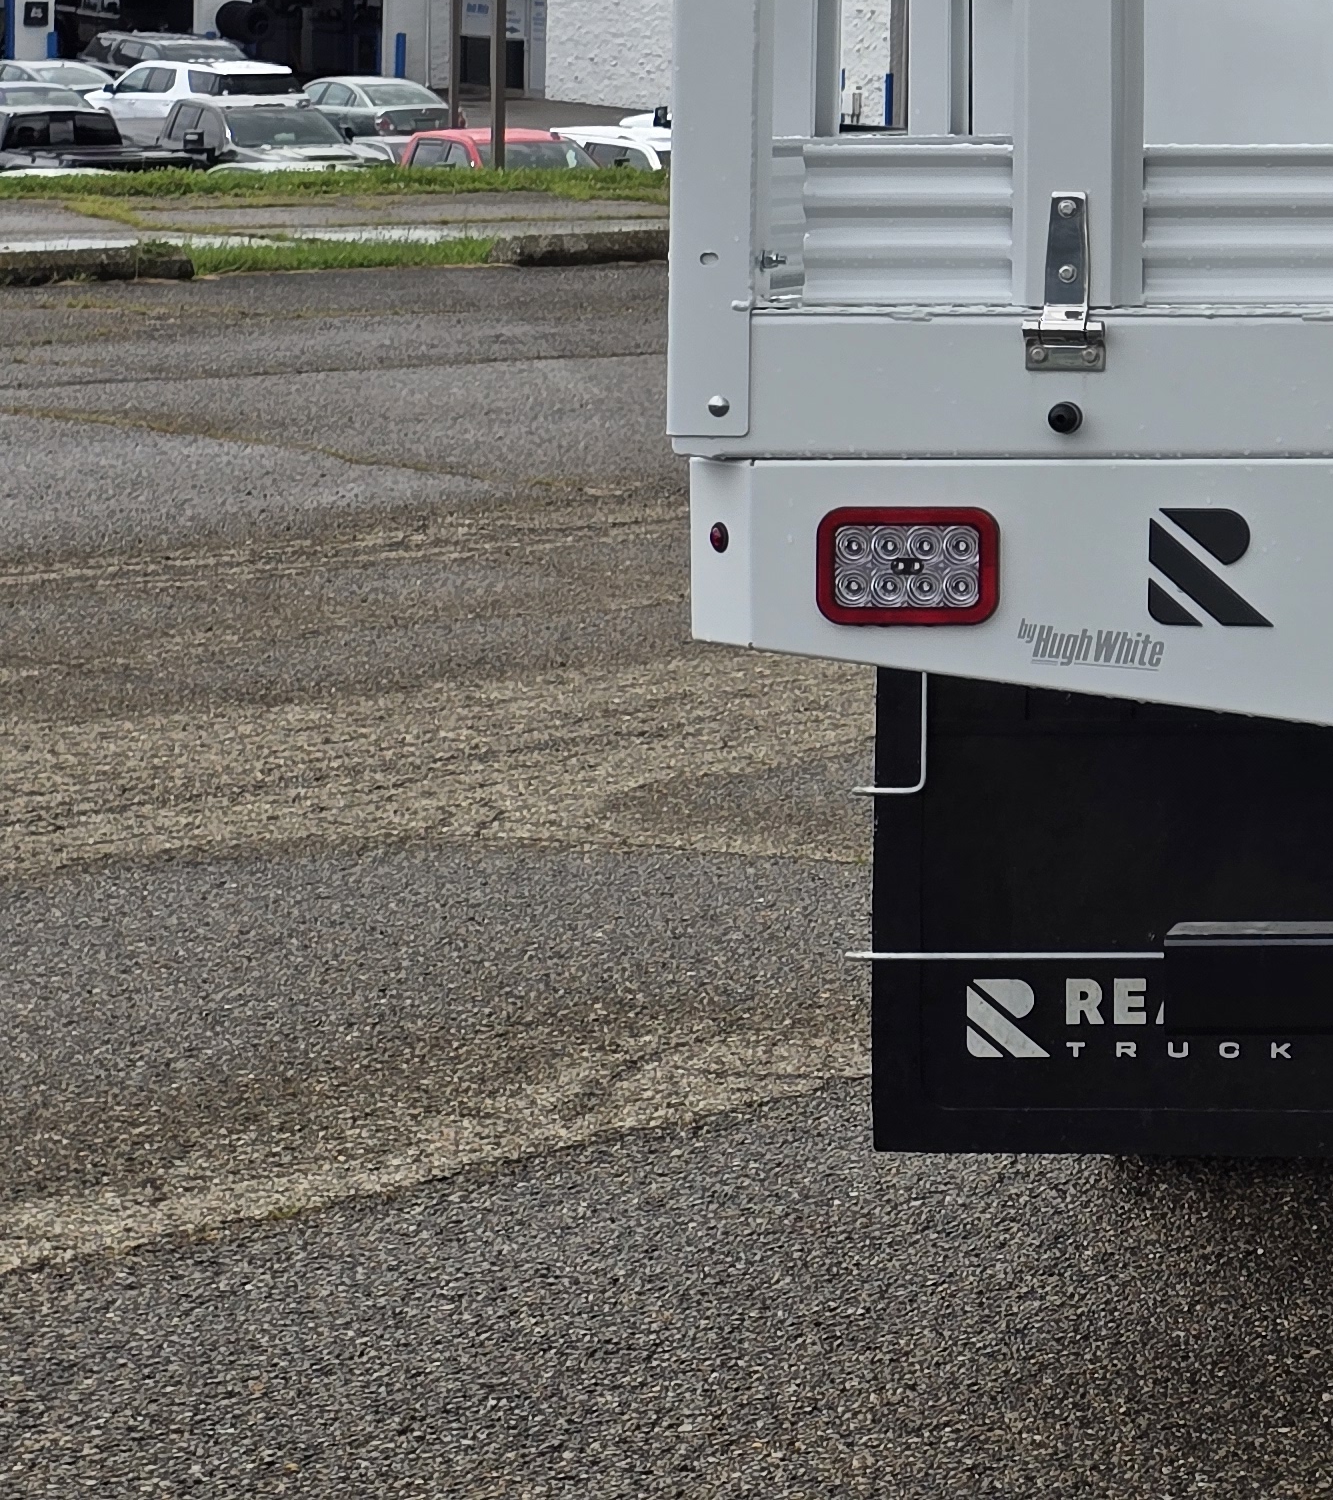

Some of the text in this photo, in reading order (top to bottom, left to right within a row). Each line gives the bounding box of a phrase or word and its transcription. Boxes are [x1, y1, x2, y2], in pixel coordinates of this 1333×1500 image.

[1017, 618, 1165, 667] by Hugh White
[1065, 977, 1165, 1025] RE
[1066, 1041, 1292, 1059] TRUCK
